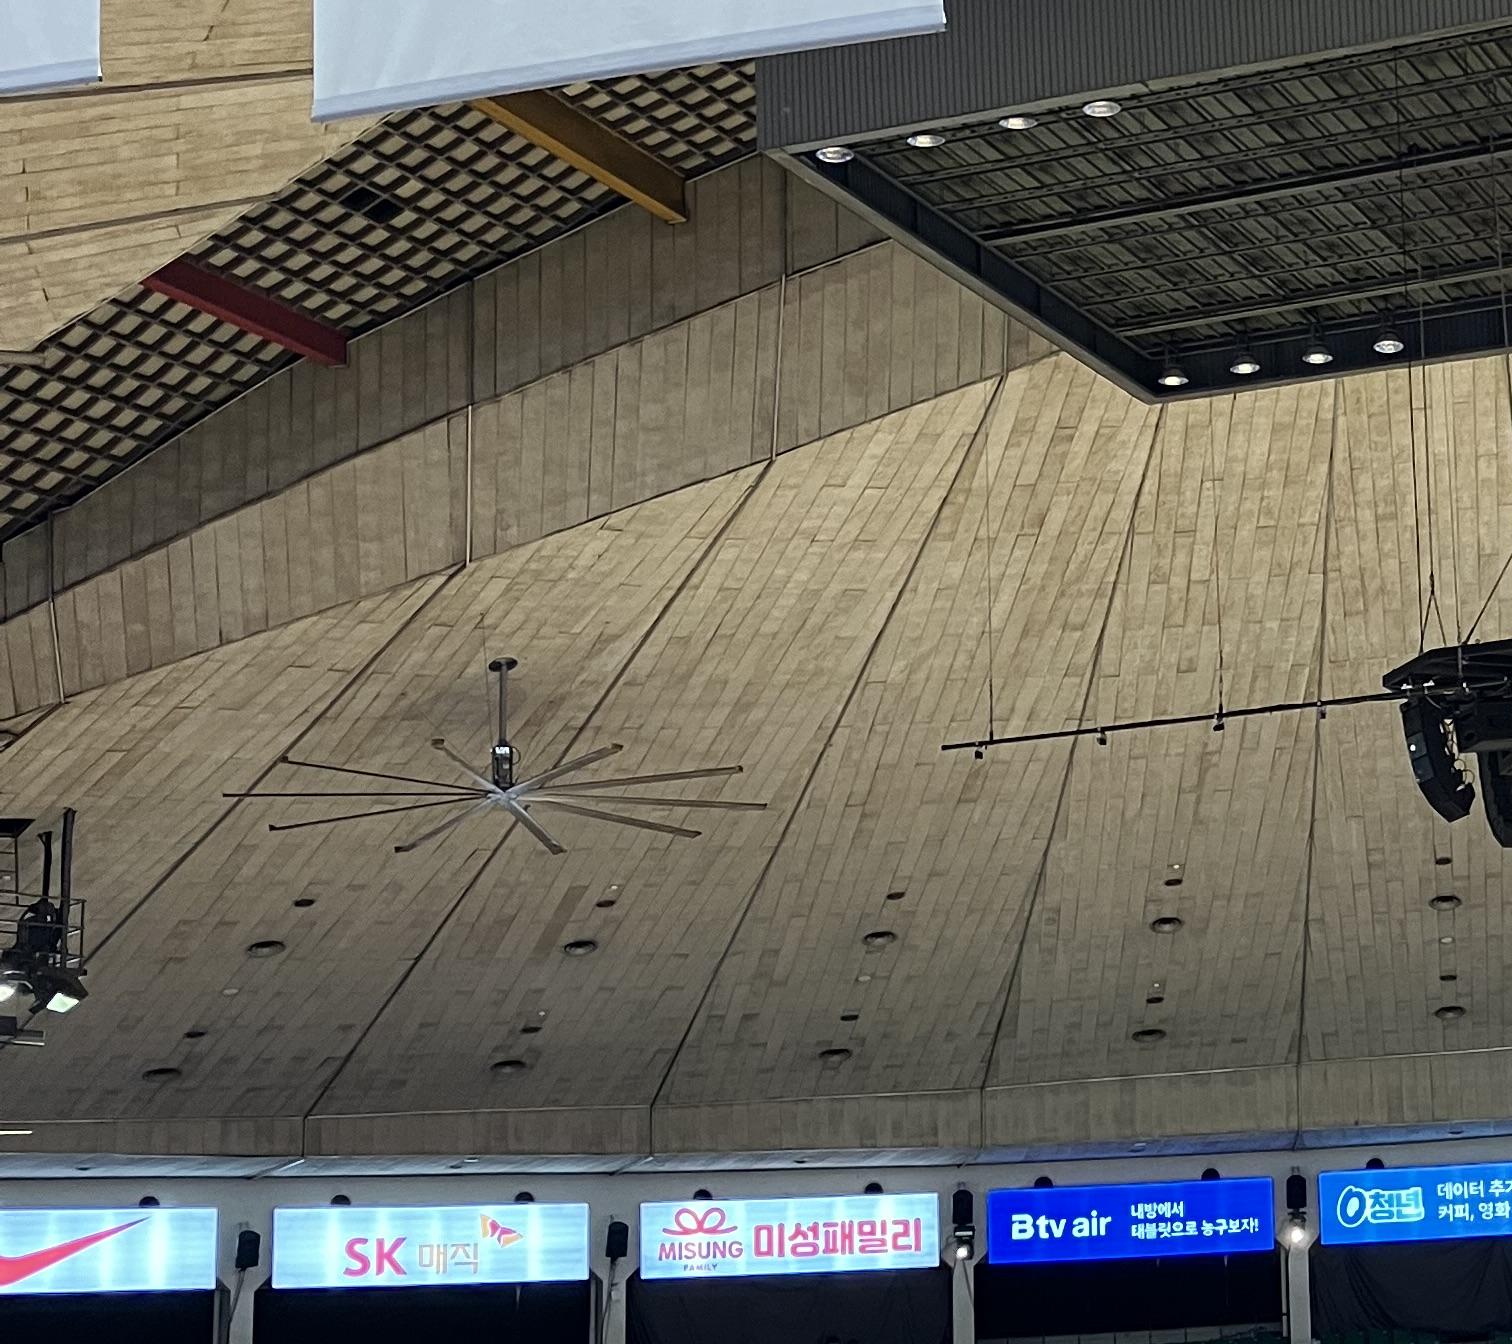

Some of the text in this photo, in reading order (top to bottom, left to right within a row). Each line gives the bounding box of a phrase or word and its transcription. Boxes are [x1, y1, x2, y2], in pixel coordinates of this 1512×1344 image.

[1437, 1180, 1484, 1199] 데이터
[1130, 1201, 1185, 1219] 내방에서
[1438, 1202, 1475, 1222] 커피,
[1478, 1202, 1511, 1219] 영화
[1011, 1210, 1112, 1240] Btv air
[1131, 1217, 1259, 1240] 태블릿으로 농구보자!
[753, 1218, 922, 1258] 미성패밀리
[343, 1237, 479, 1277] SK 매직
[659, 1240, 744, 1261] MISUNG
